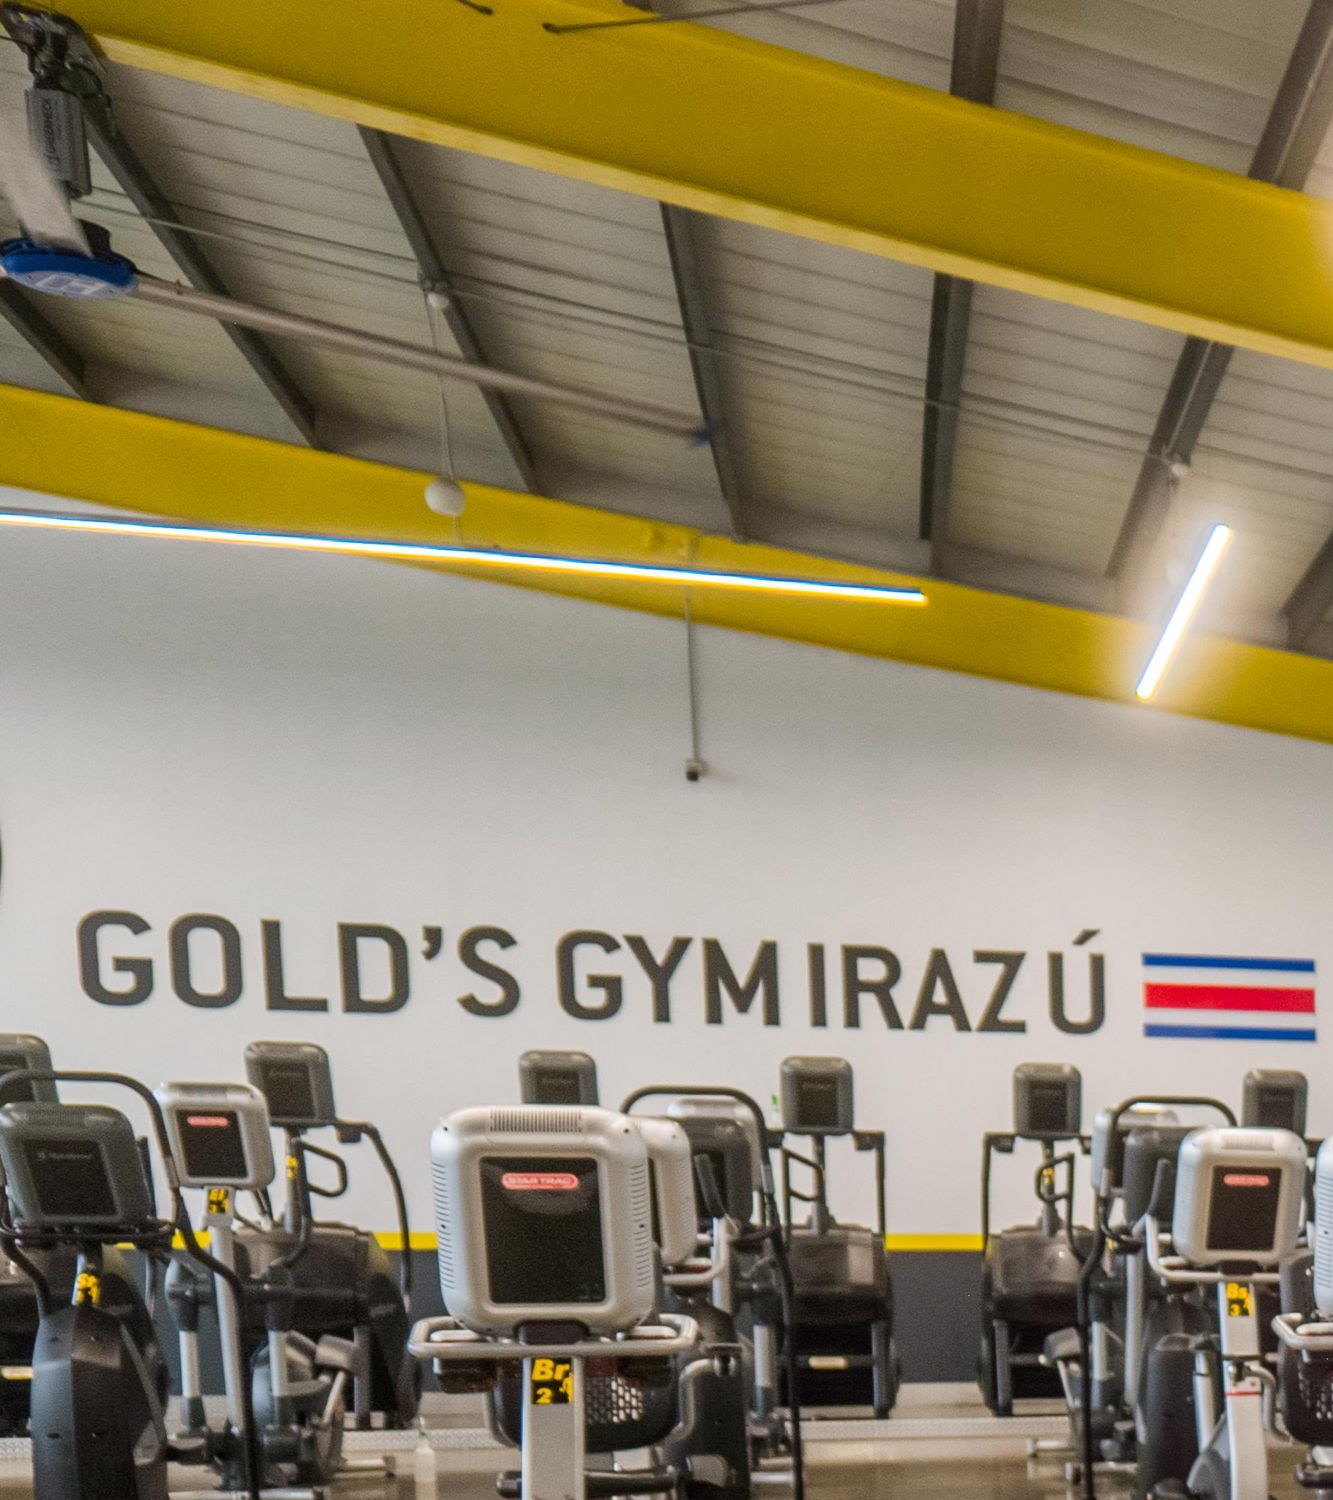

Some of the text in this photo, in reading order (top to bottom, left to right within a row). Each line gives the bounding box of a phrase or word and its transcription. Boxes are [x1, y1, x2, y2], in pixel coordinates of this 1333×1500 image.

[77, 909, 1106, 1036] GOLD'S GYM IRAZÚ
[531, 1358, 571, 1381] Br
[536, 1387, 551, 1404] 2
